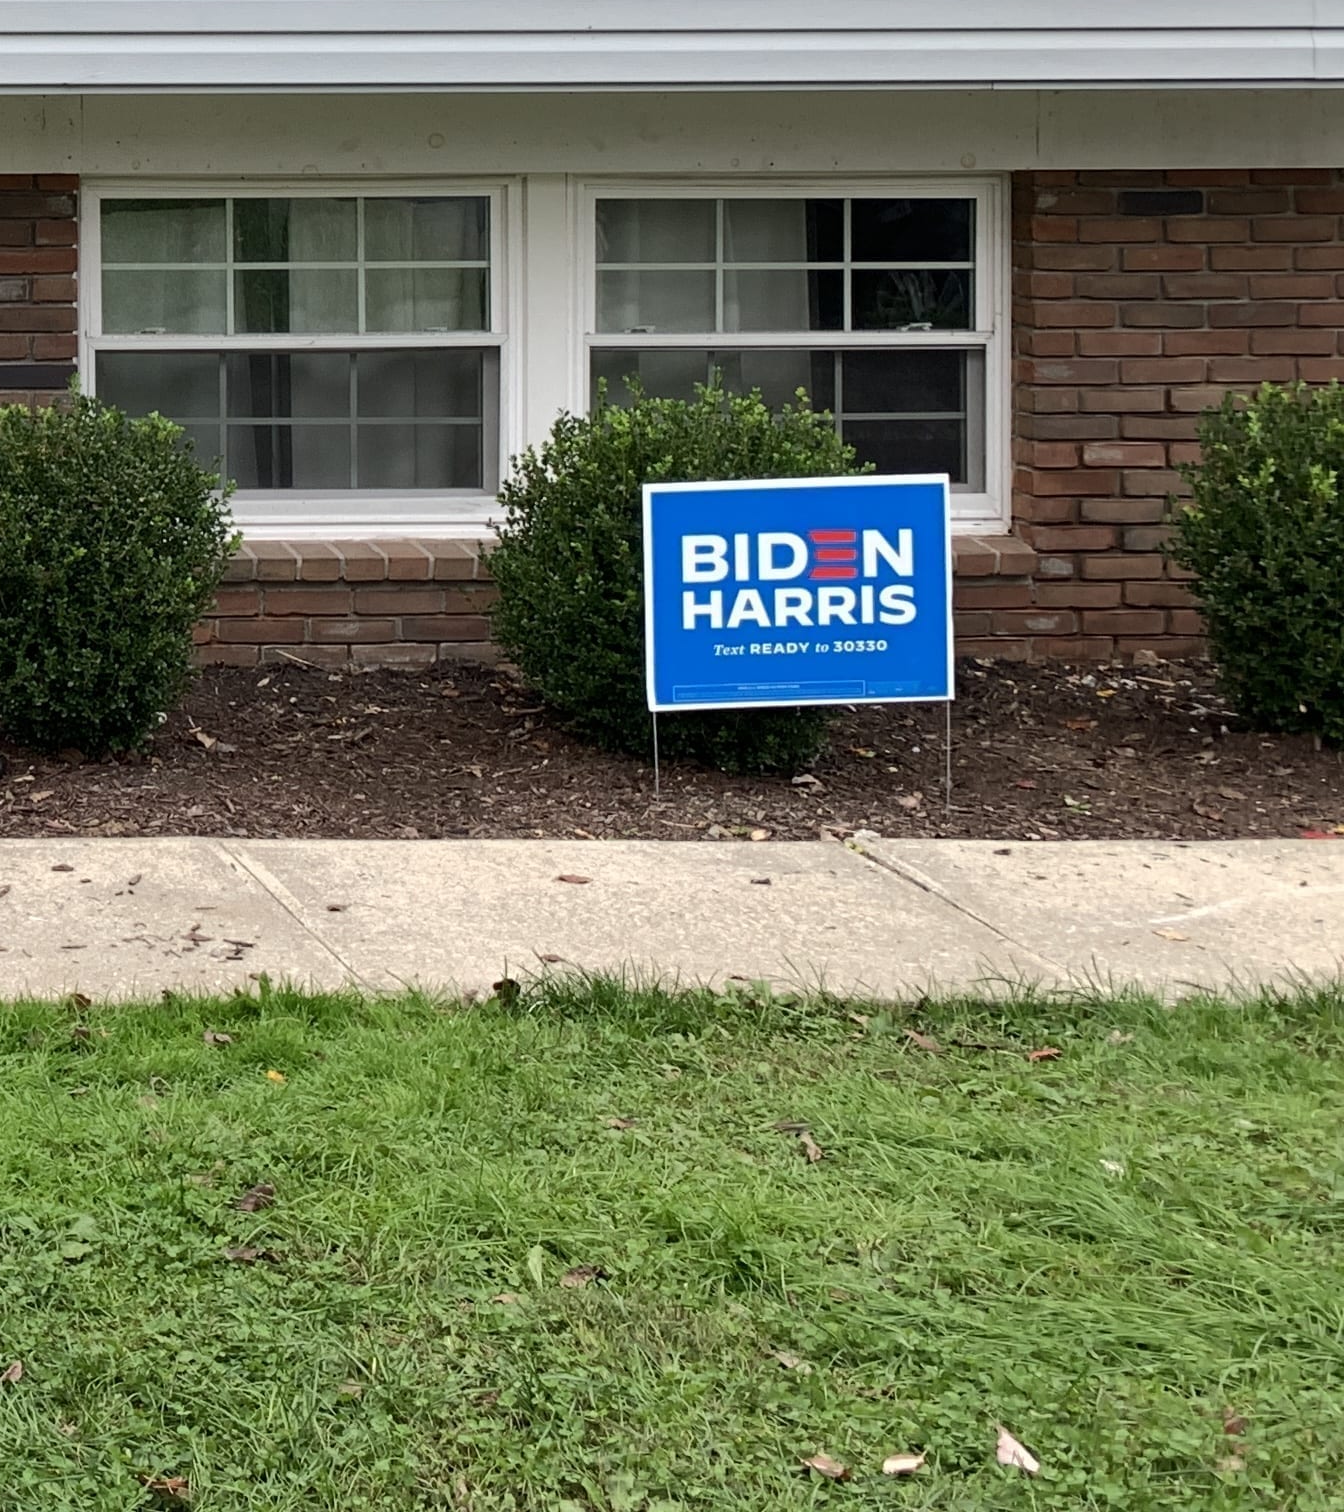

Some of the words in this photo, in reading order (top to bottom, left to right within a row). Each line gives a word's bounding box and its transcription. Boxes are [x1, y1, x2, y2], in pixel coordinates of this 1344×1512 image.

[681, 529, 914, 583] BIDEN
[682, 584, 918, 630] HARRIS
[713, 643, 745, 656] Text
[749, 642, 810, 655] READY
[815, 642, 829, 654] to
[833, 639, 888, 653] 30330
